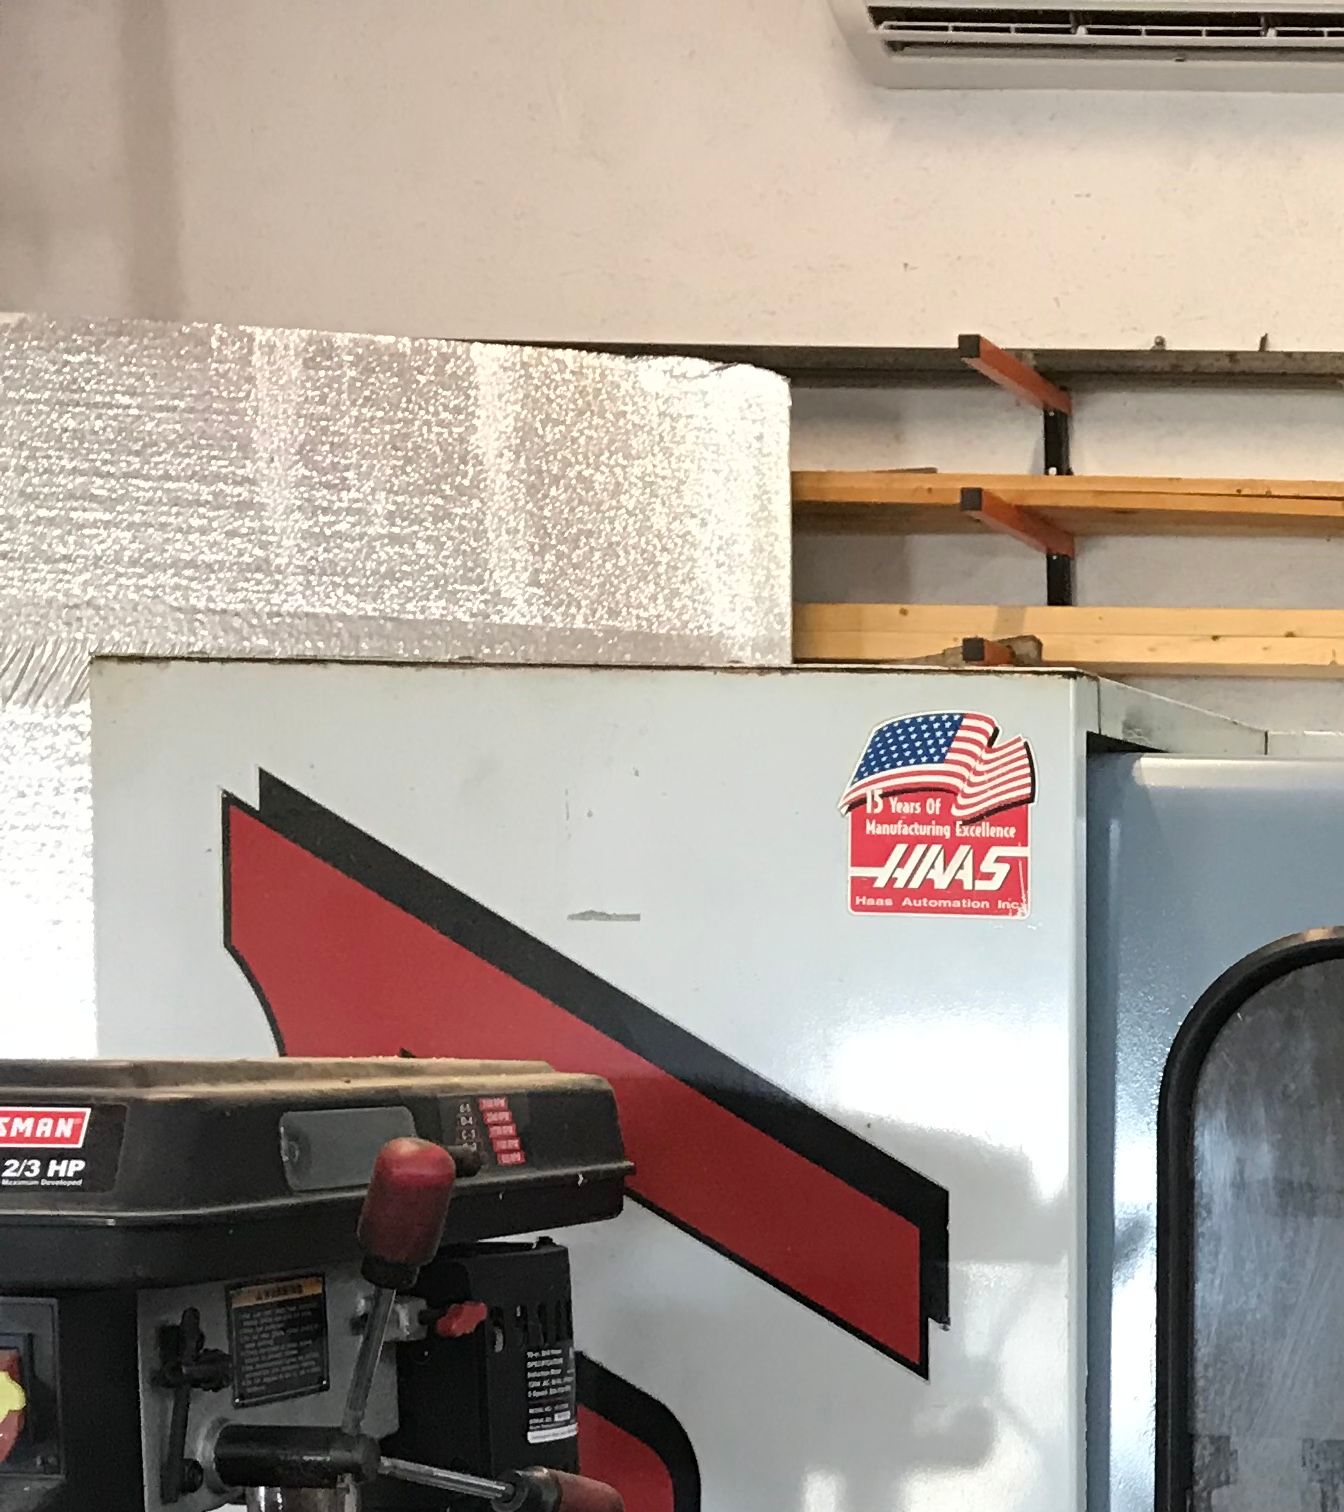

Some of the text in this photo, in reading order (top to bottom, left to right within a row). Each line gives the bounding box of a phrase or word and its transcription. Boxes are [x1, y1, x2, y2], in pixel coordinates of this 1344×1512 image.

[866, 789, 941, 814] 15 Years Of
[866, 820, 1016, 839] Manufacturing Excellence
[862, 843, 1022, 891] HAAS
[856, 896, 892, 906] Haas
[902, 896, 989, 909] Automation
[47, 1160, 86, 1177] HP
